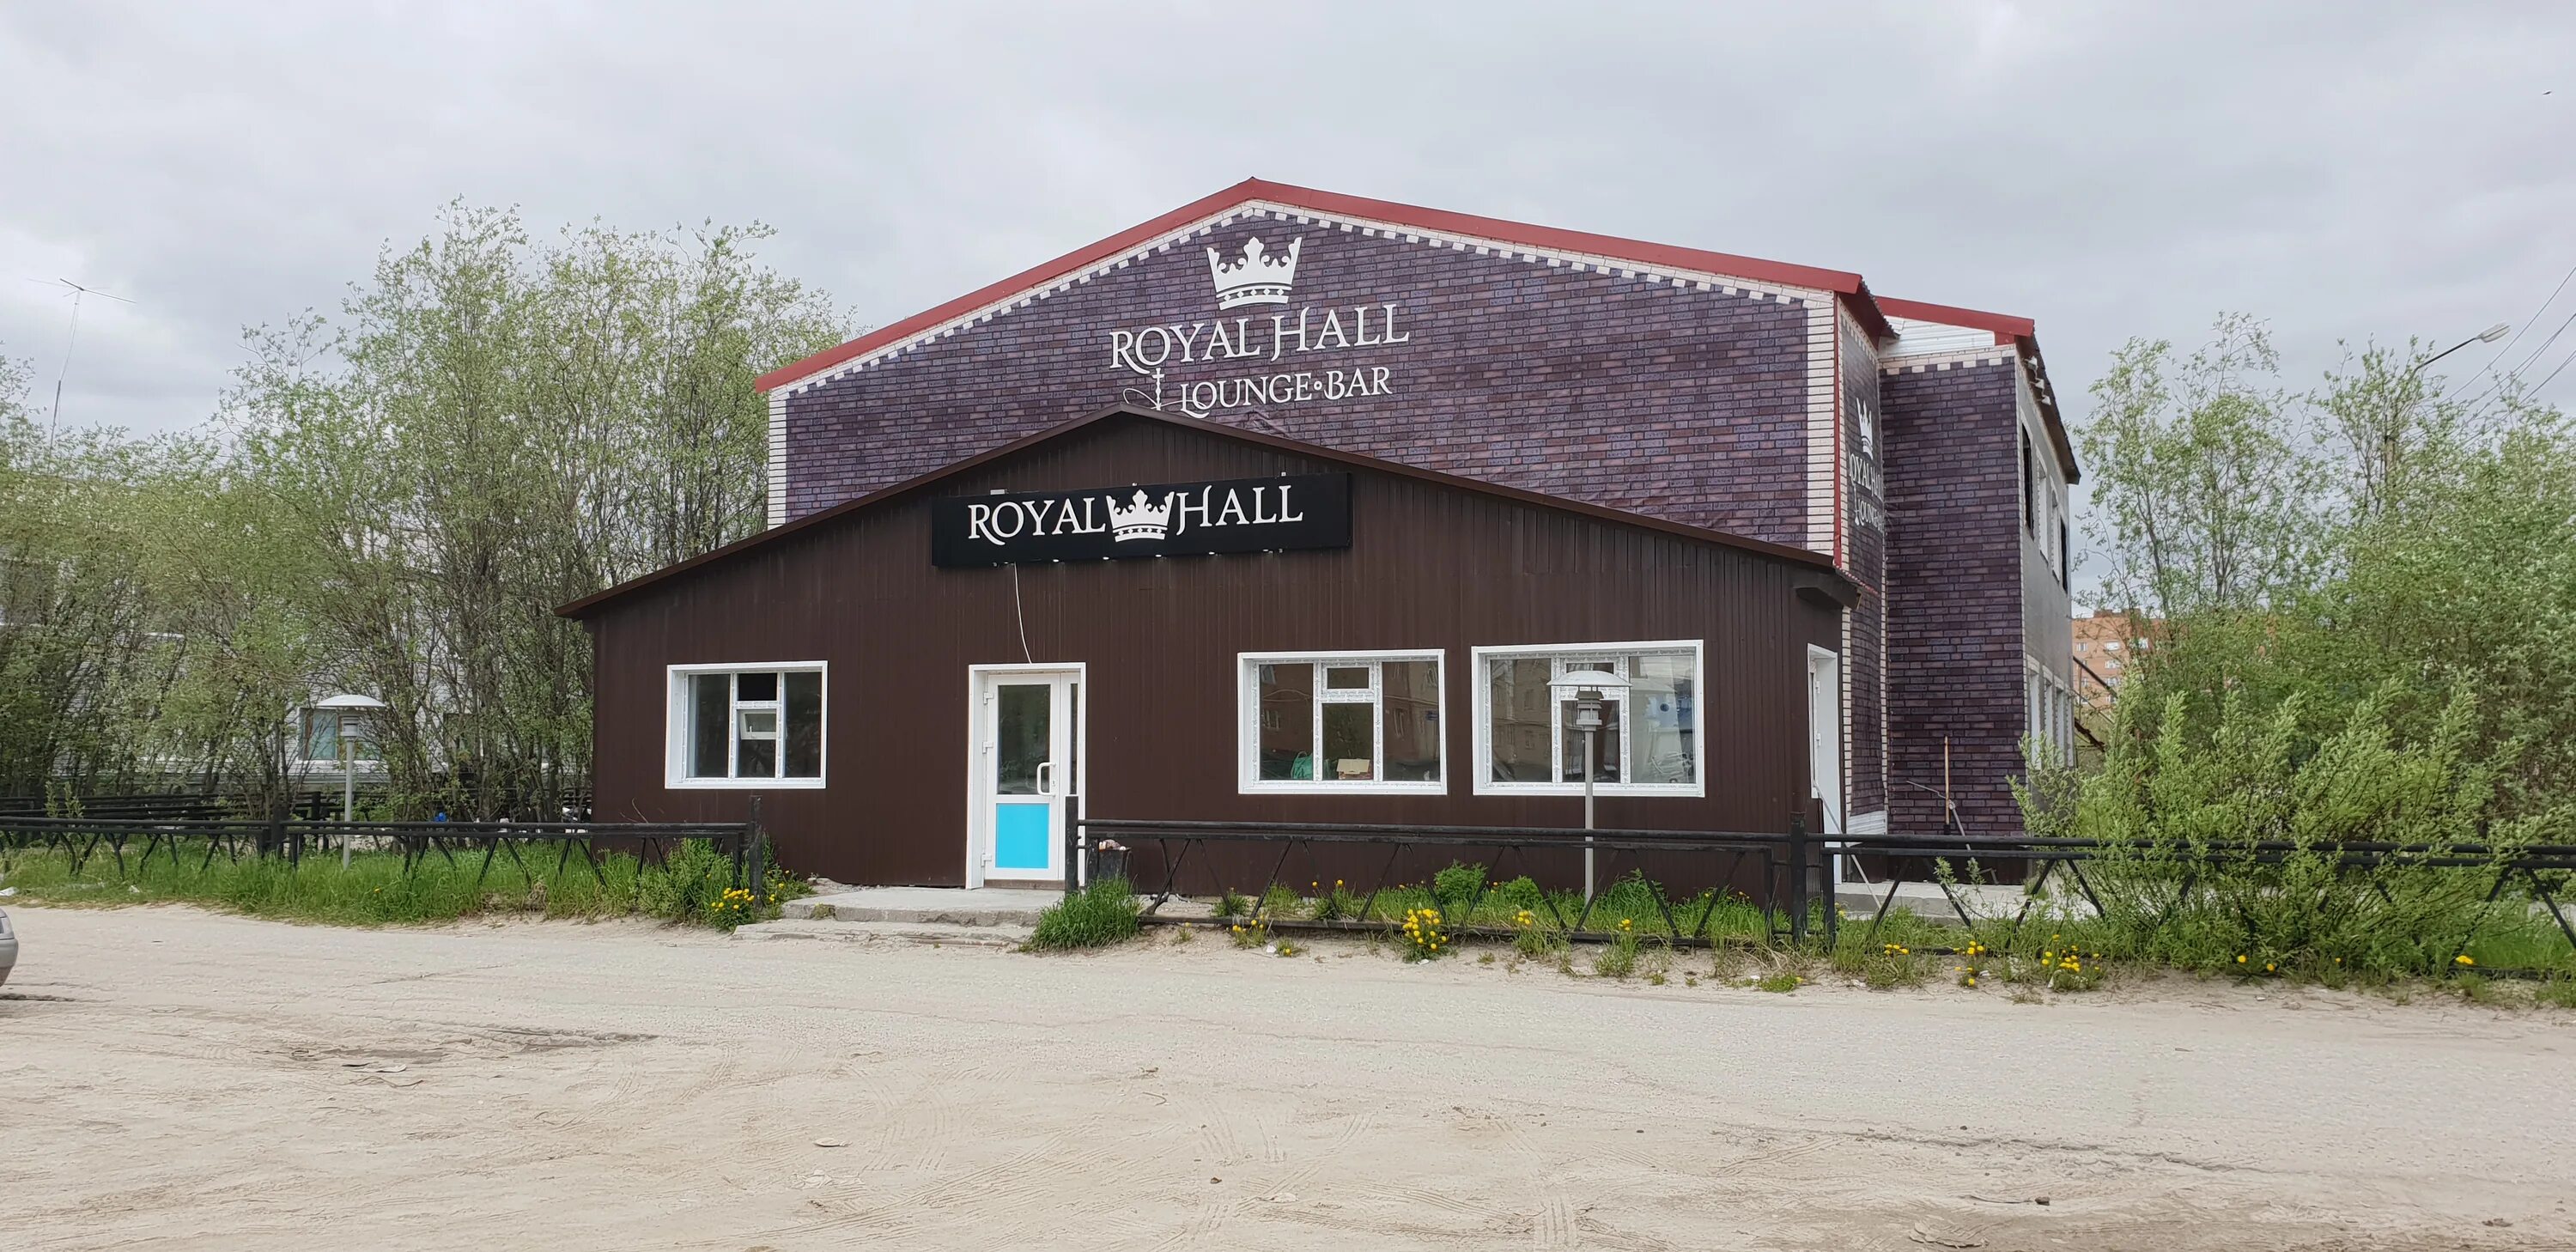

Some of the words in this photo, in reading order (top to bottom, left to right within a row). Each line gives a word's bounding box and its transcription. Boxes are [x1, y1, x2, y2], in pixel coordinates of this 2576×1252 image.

[1109, 318, 1261, 375] ROYAL
[1270, 303, 1410, 362] HALL
[968, 497, 1106, 546] ROYAL
[1176, 484, 1303, 536] HALL
